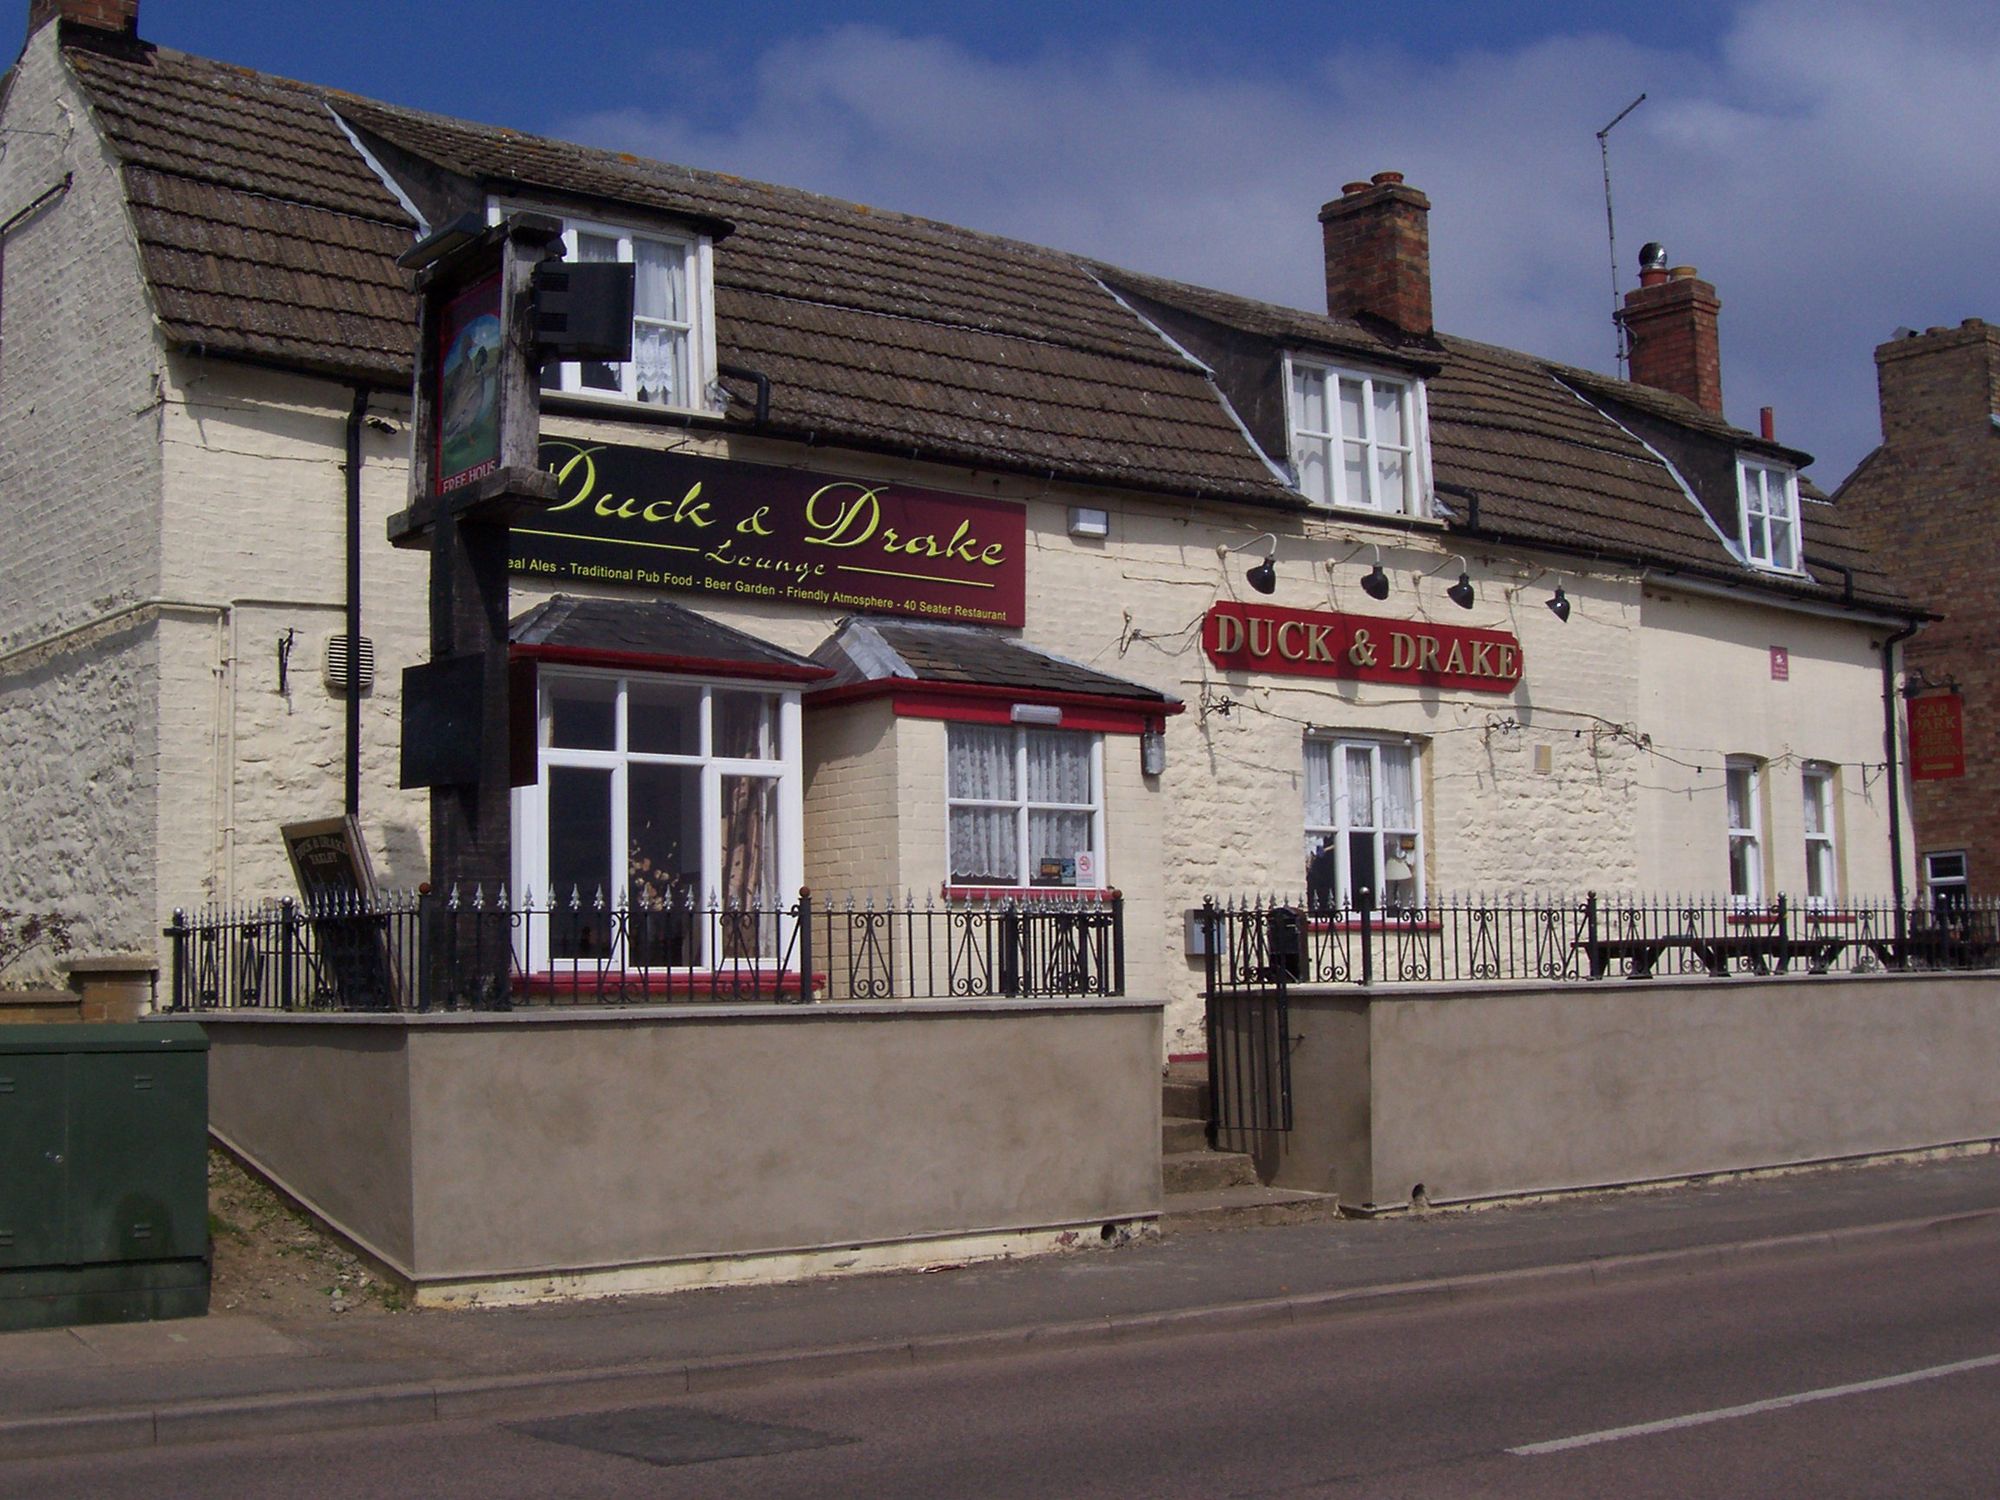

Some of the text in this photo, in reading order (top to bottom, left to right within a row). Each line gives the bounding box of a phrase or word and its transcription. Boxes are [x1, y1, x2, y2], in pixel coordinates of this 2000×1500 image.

[443, 459, 497, 494] FREE HOUS
[538, 440, 1007, 566] Duck & Drake
[704, 538, 826, 583] Lounge
[508, 558, 526, 570] eal
[529, 559, 557, 573] Ales
[570, 562, 633, 581] Traditional
[637, 569, 660, 584] Pub
[663, 572, 692, 587] Food
[704, 576, 732, 591] Beer
[735, 580, 776, 596] Garden
[787, 586, 830, 604] Friendly
[832, 592, 894, 610] Atmosphere
[904, 600, 916, 612] 40
[919, 601, 952, 615] Seater
[954, 605, 1007, 622] Restaurant
[1214, 614, 1518, 680] DUCK & DRAKE
[1913, 715, 1957, 731] PARK
[1918, 703, 1950, 717] CAR
